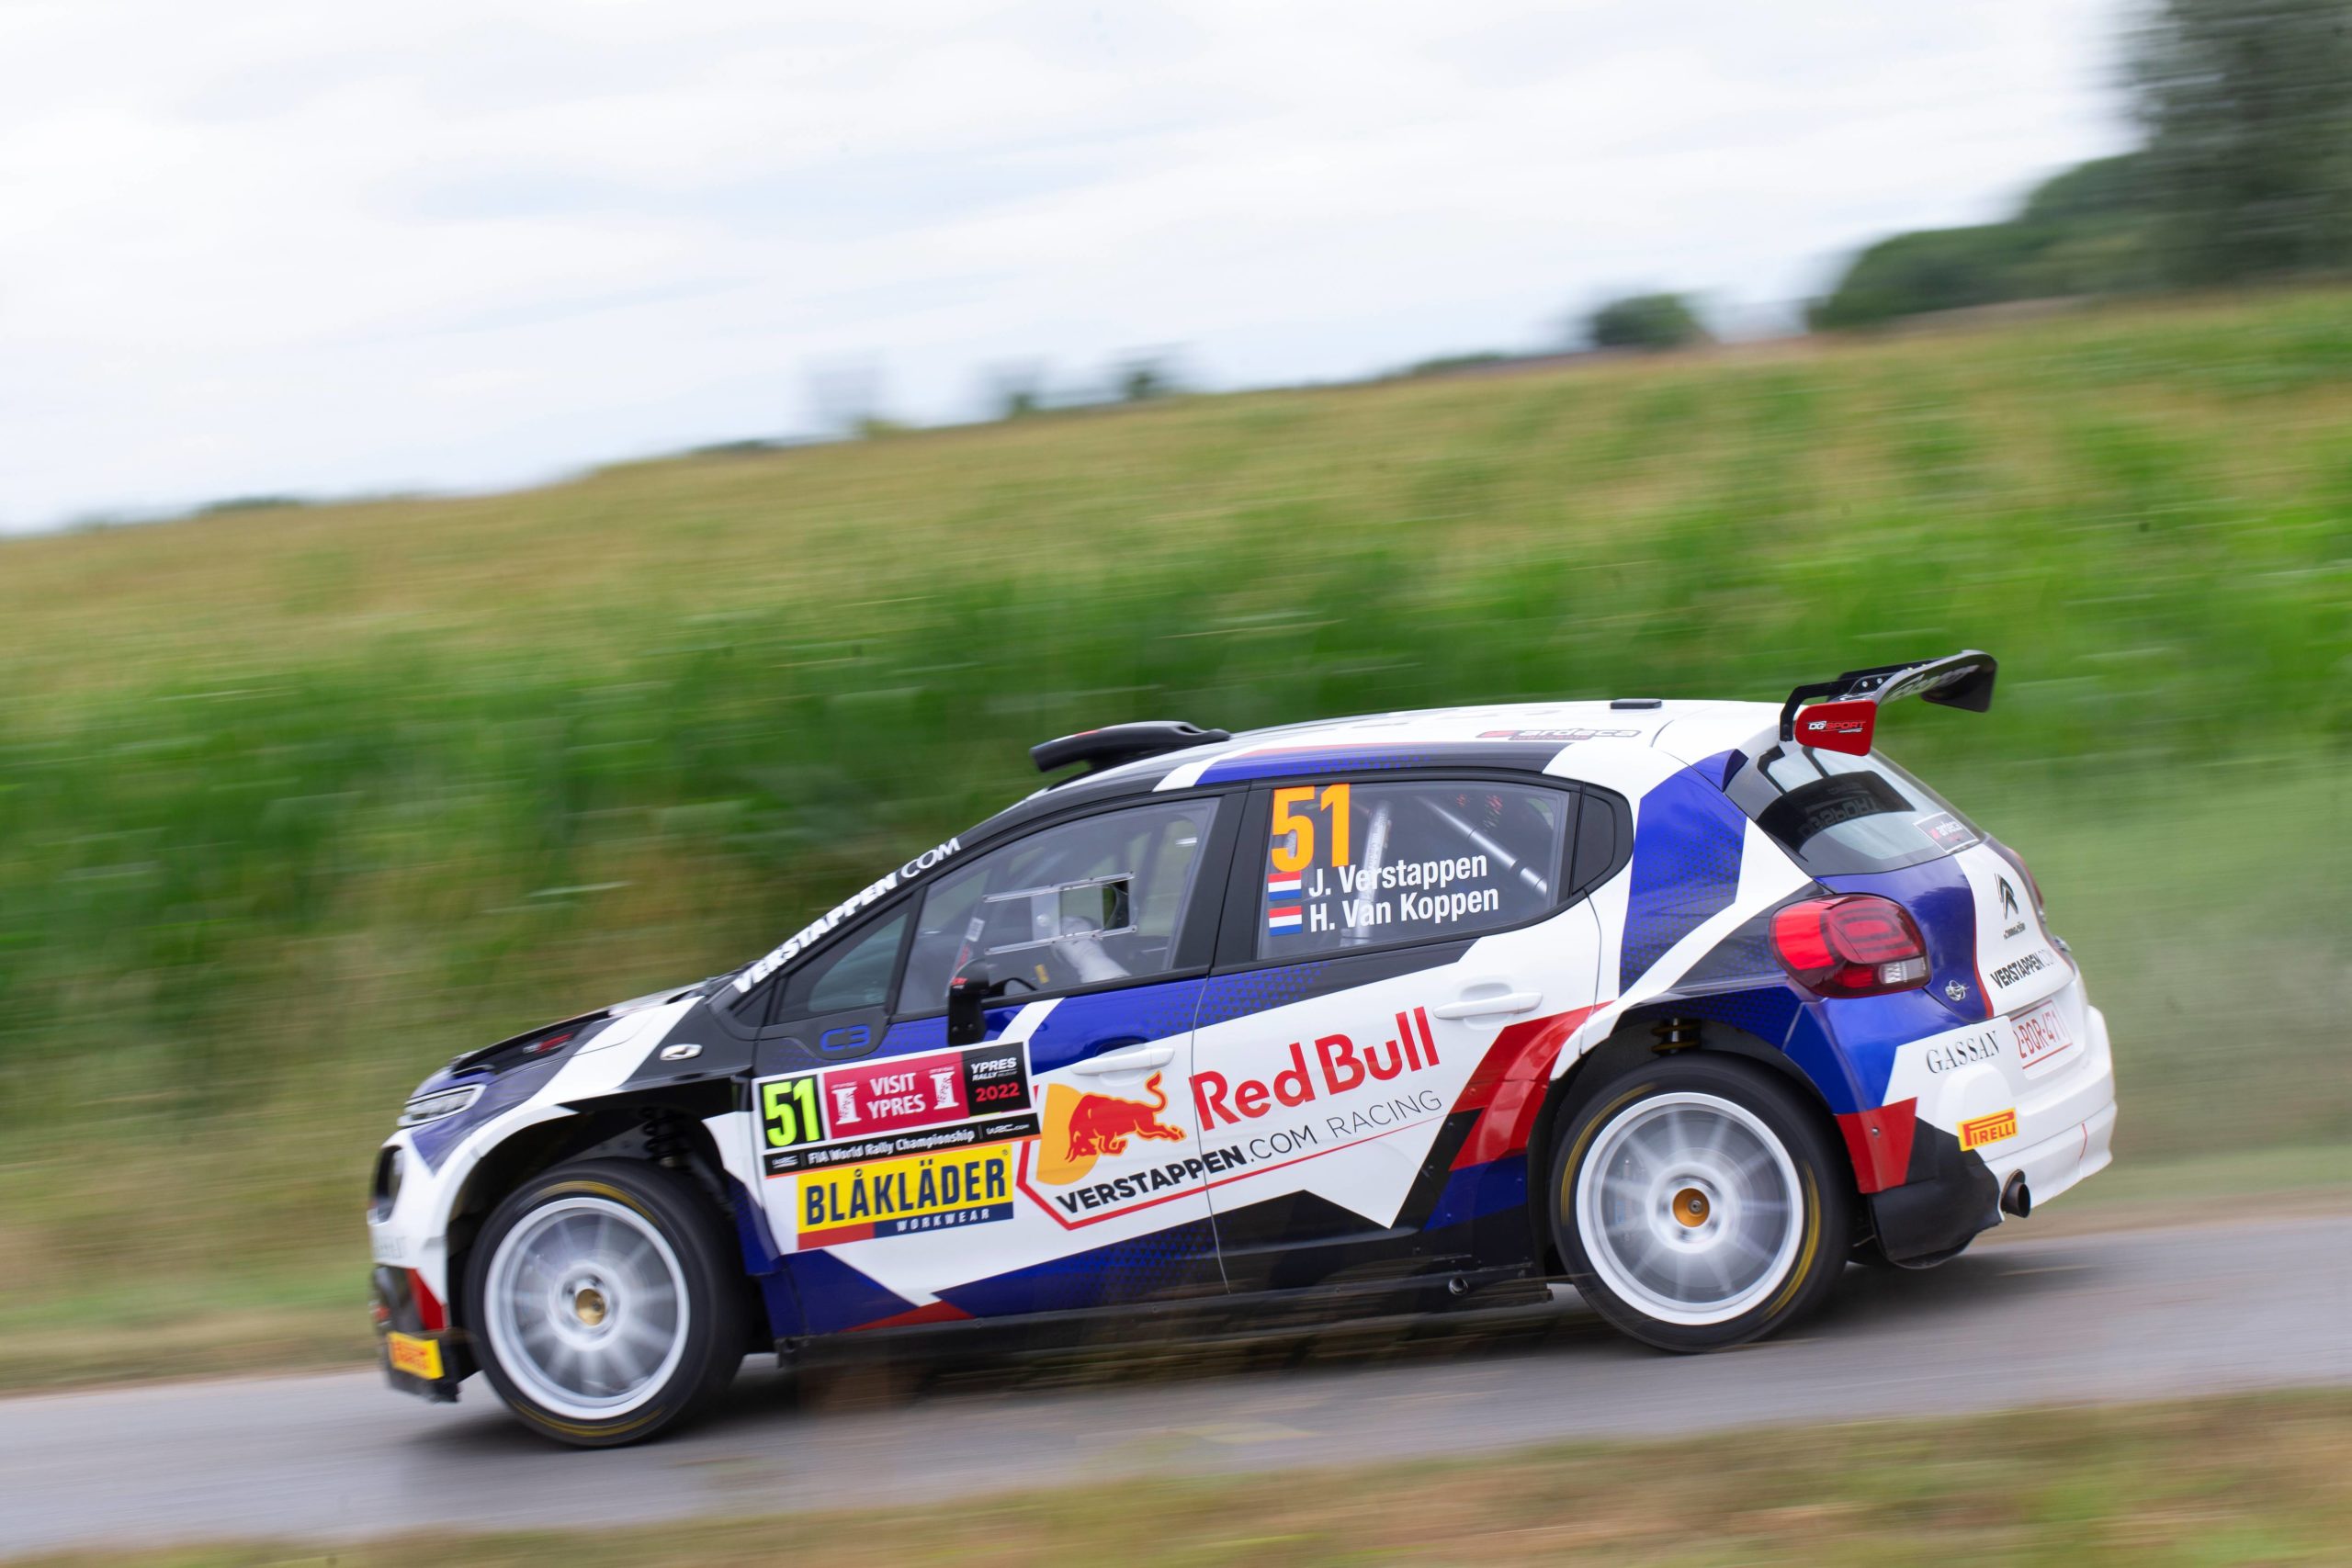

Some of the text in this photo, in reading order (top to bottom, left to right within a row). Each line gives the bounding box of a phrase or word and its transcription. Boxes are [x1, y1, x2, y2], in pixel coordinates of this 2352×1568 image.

[1271, 783, 1351, 873] 51
[1308, 854, 1487, 897] J. Verstappen
[1309, 888, 1499, 932] H. Van Koppen
[970, 1057, 1017, 1074] YPRES
[1188, 1006, 1441, 1132] Red Bull
[1926, 1030, 1999, 1074] GASSAN
[869, 1072, 917, 1097] VISIT
[972, 1071, 997, 1081] RALLY
[975, 1082, 1020, 1102] 2022
[762, 1077, 820, 1147] 51
[866, 1094, 926, 1120] YPRES
[1327, 1089, 1443, 1139] RACING
[808, 1129, 976, 1165] FIA World Rally Championship
[1962, 1111, 2017, 1148] PIRELLI
[806, 1158, 1006, 1226] BLÅKLÄDER
[896, 1208, 990, 1232] WORKWEAR
